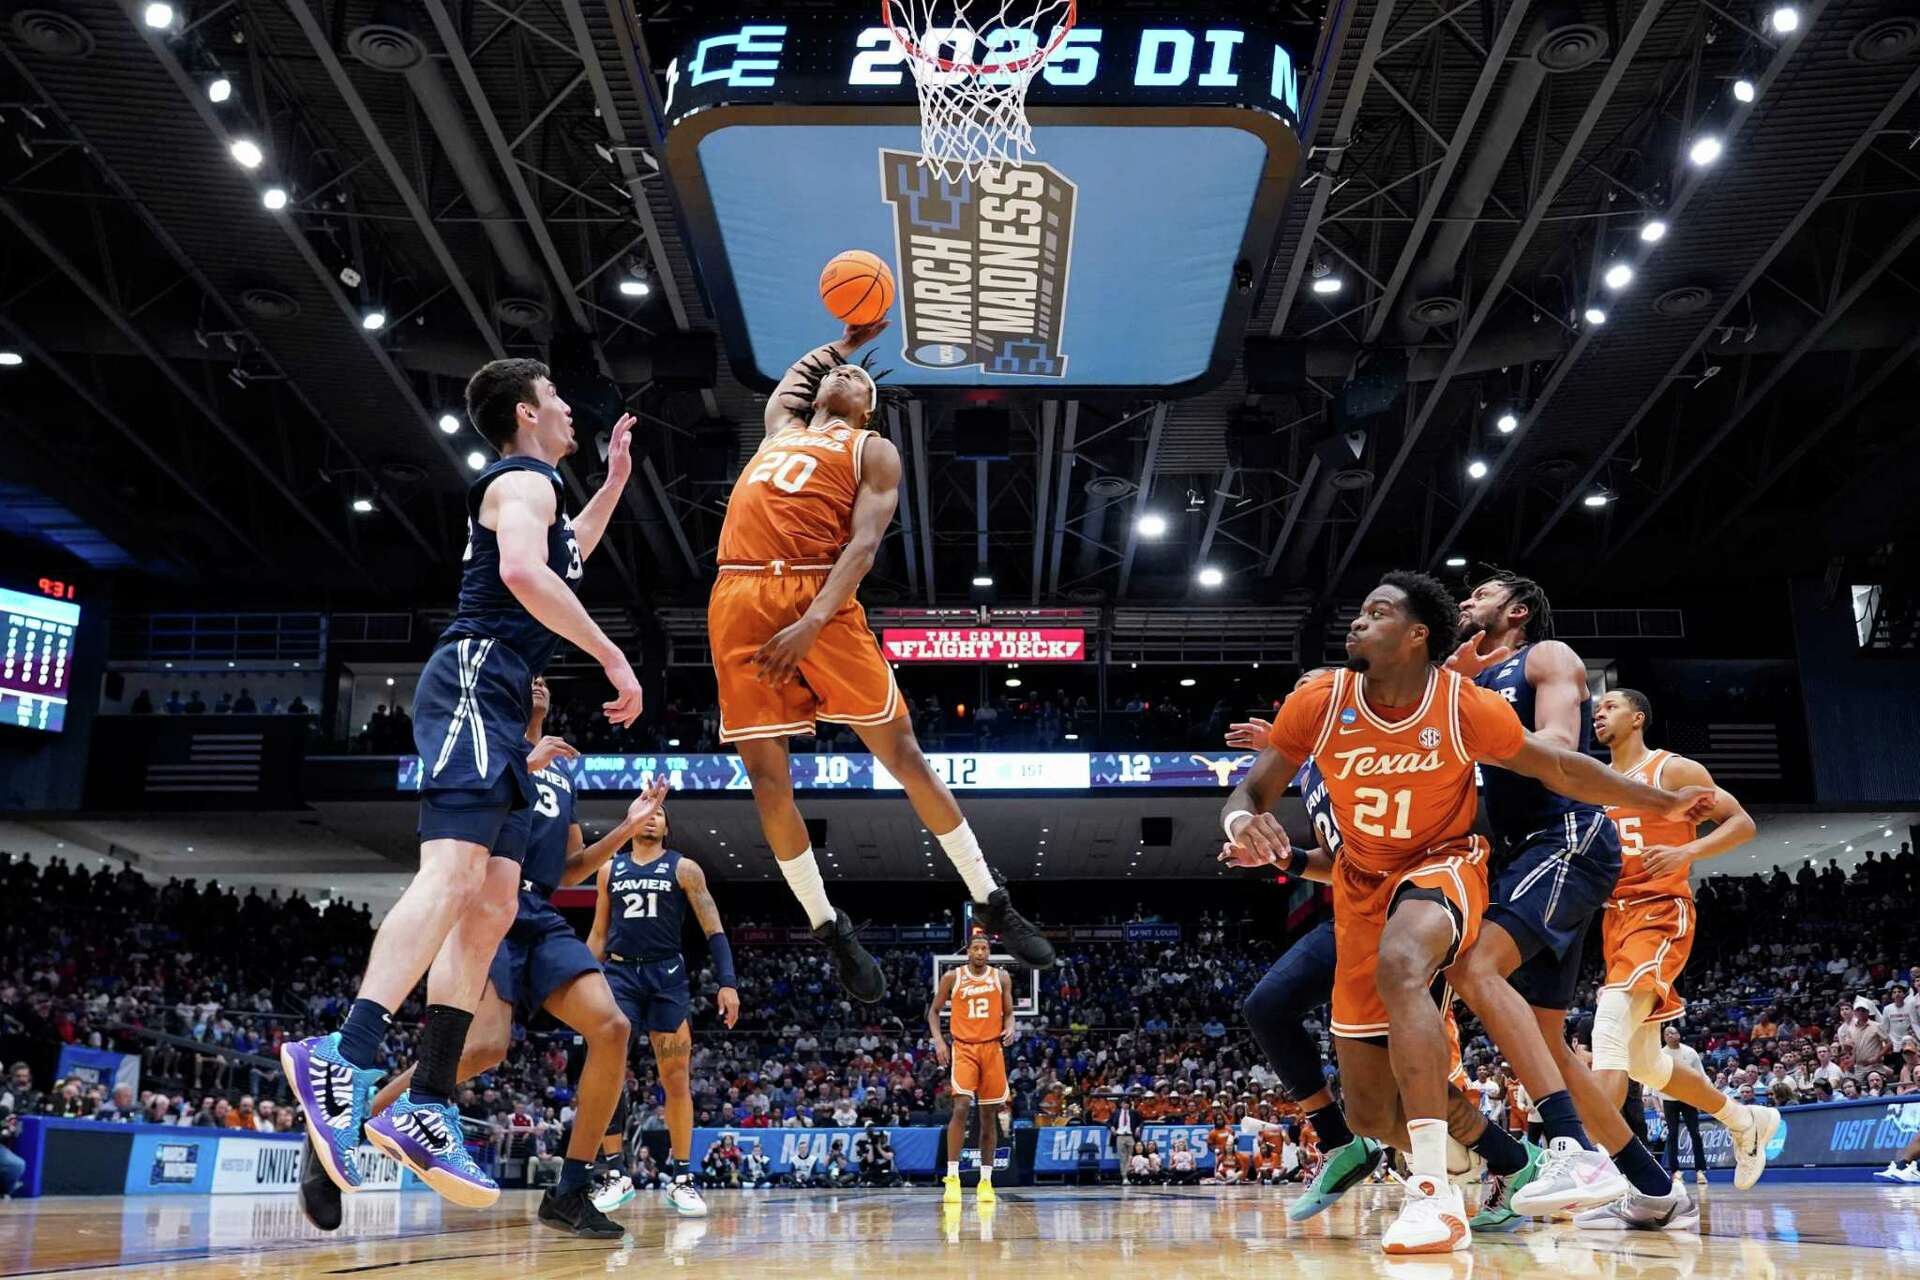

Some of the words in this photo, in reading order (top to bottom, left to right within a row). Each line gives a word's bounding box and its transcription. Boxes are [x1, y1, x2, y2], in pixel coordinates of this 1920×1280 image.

[848, 27, 1102, 86] 2025
[1134, 29, 1245, 86] DI
[978, 165, 1044, 334] MADNESS
[911, 234, 972, 344] MARCH
[748, 451, 818, 493] 20
[901, 641, 993, 658] FLIGHT
[1000, 641, 1066, 658] DECK
[926, 632, 961, 642] THE
[815, 756, 849, 783] 10
[1118, 754, 1151, 782] 12
[1334, 746, 1445, 780] Texas
[532, 769, 572, 793] VIER
[533, 783, 560, 818] 3
[1353, 786, 1413, 839] 21
[612, 879, 672, 892] XAVIER
[622, 892, 658, 919] 21
[967, 998, 989, 1019] 12
[1830, 1120, 1876, 1151] VISIT
[256, 1148, 301, 1184] UNIVE
